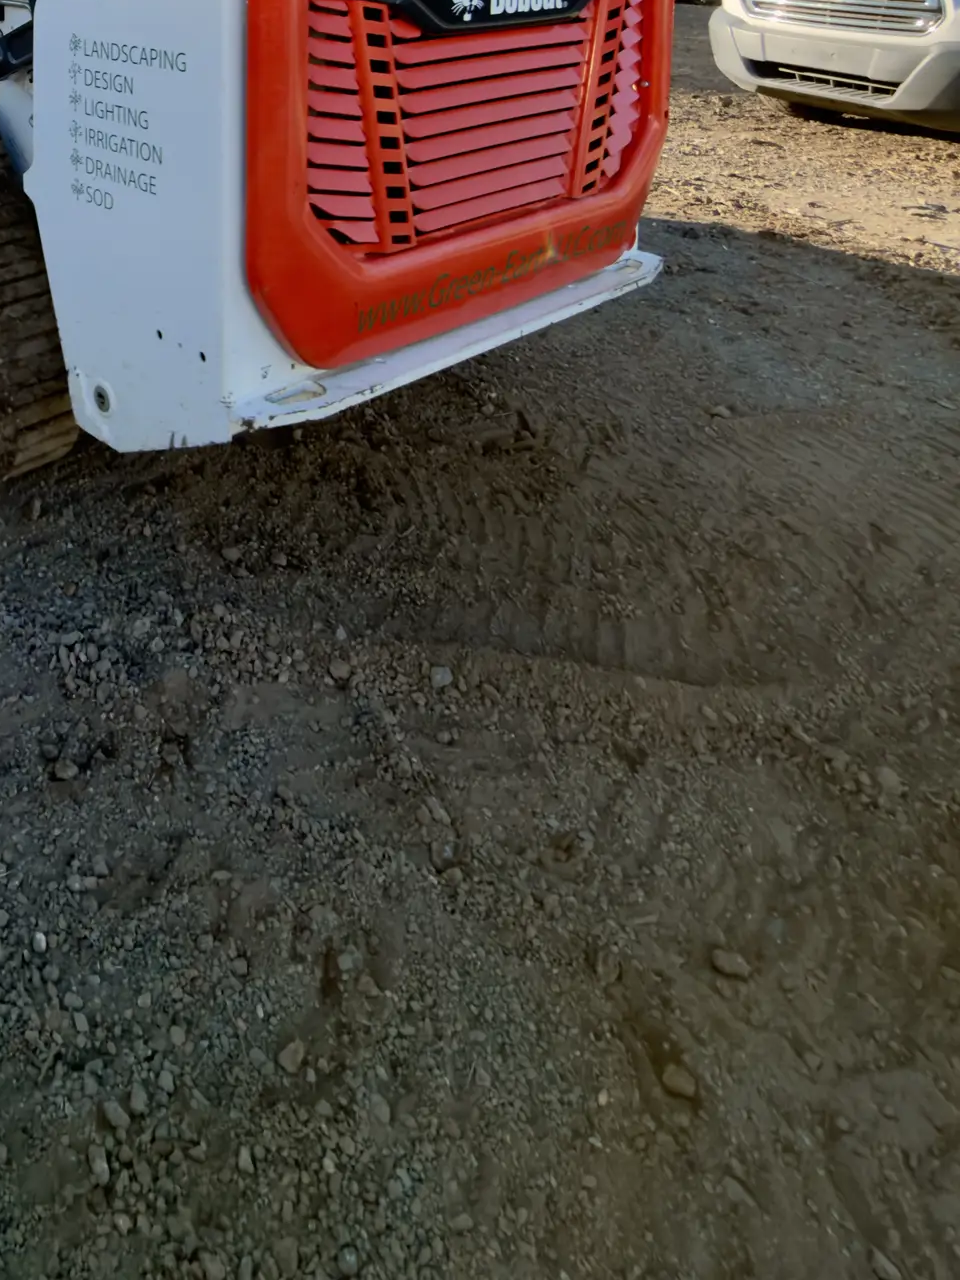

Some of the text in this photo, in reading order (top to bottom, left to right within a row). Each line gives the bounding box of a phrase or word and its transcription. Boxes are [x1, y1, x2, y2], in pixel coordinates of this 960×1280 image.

[83, 38, 187, 73] LANDSCAPING
[84, 68, 134, 95] DESIGN
[84, 97, 149, 130] LIGHTING
[84, 127, 163, 165] IRRIGATION
[85, 156, 157, 195] DRAINAGE
[85, 185, 114, 210] SOD
